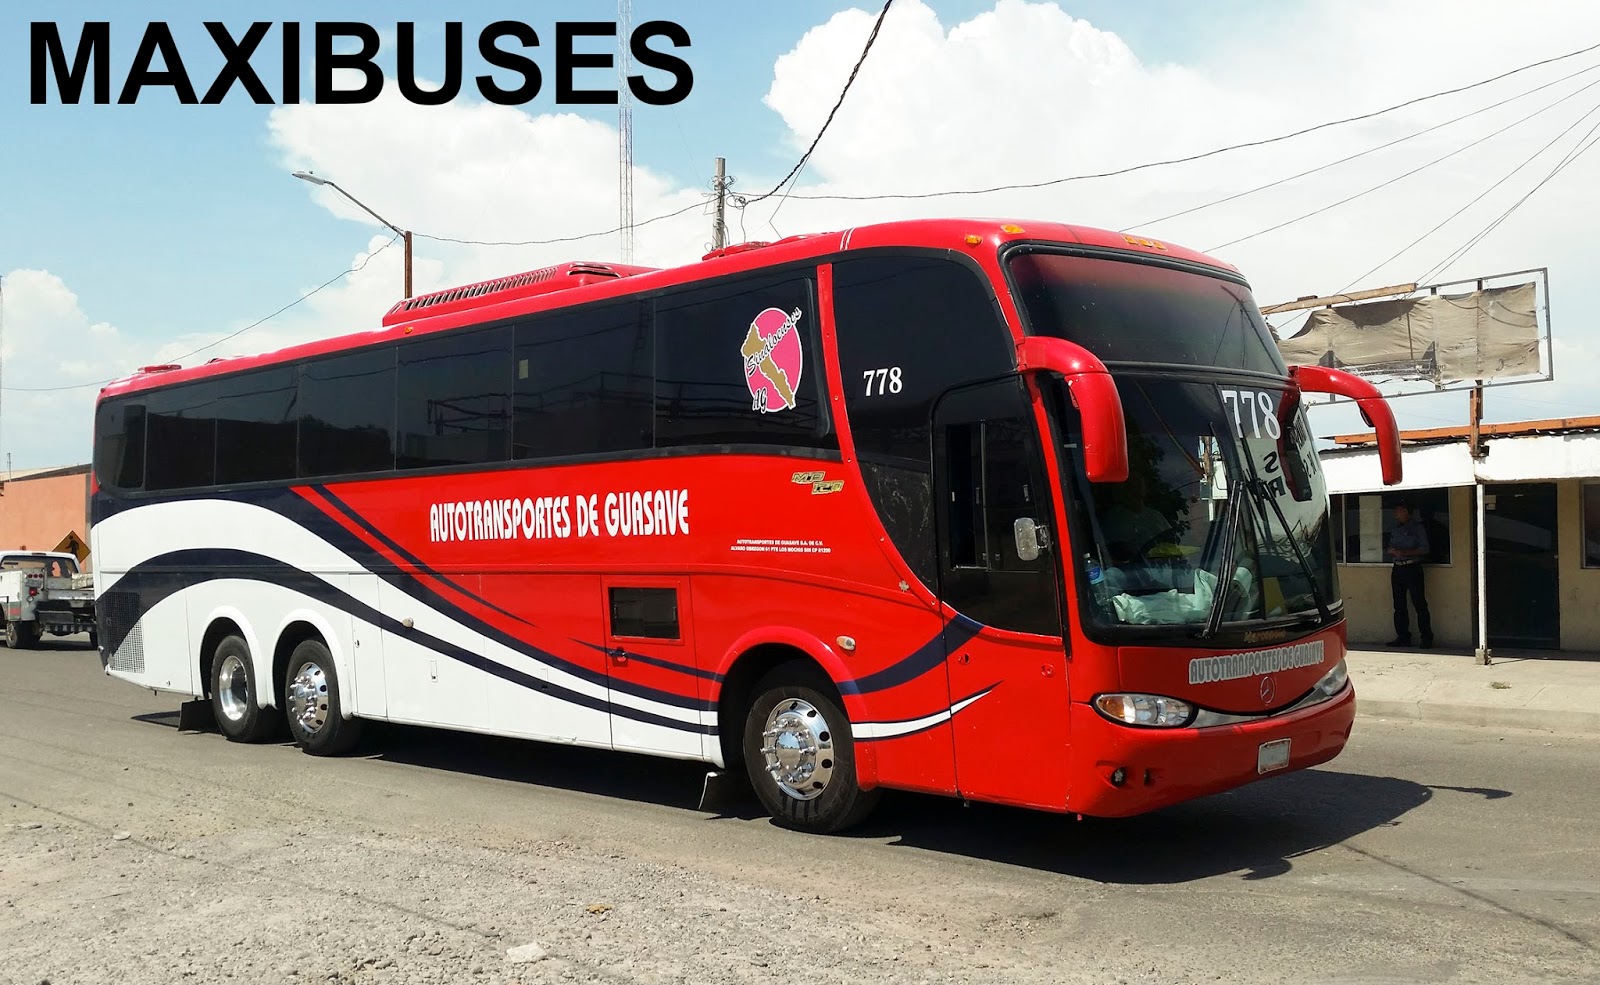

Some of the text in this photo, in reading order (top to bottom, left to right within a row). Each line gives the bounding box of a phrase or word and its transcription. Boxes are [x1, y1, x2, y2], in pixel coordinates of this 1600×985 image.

[863, 366, 903, 397] 778
[1221, 389, 1281, 440] 778
[430, 489, 689, 542] AUTOTRANSPORTES DE GUASAVE
[1189, 640, 1324, 684] AUTOTRANSPORTES DE GUASAVE
